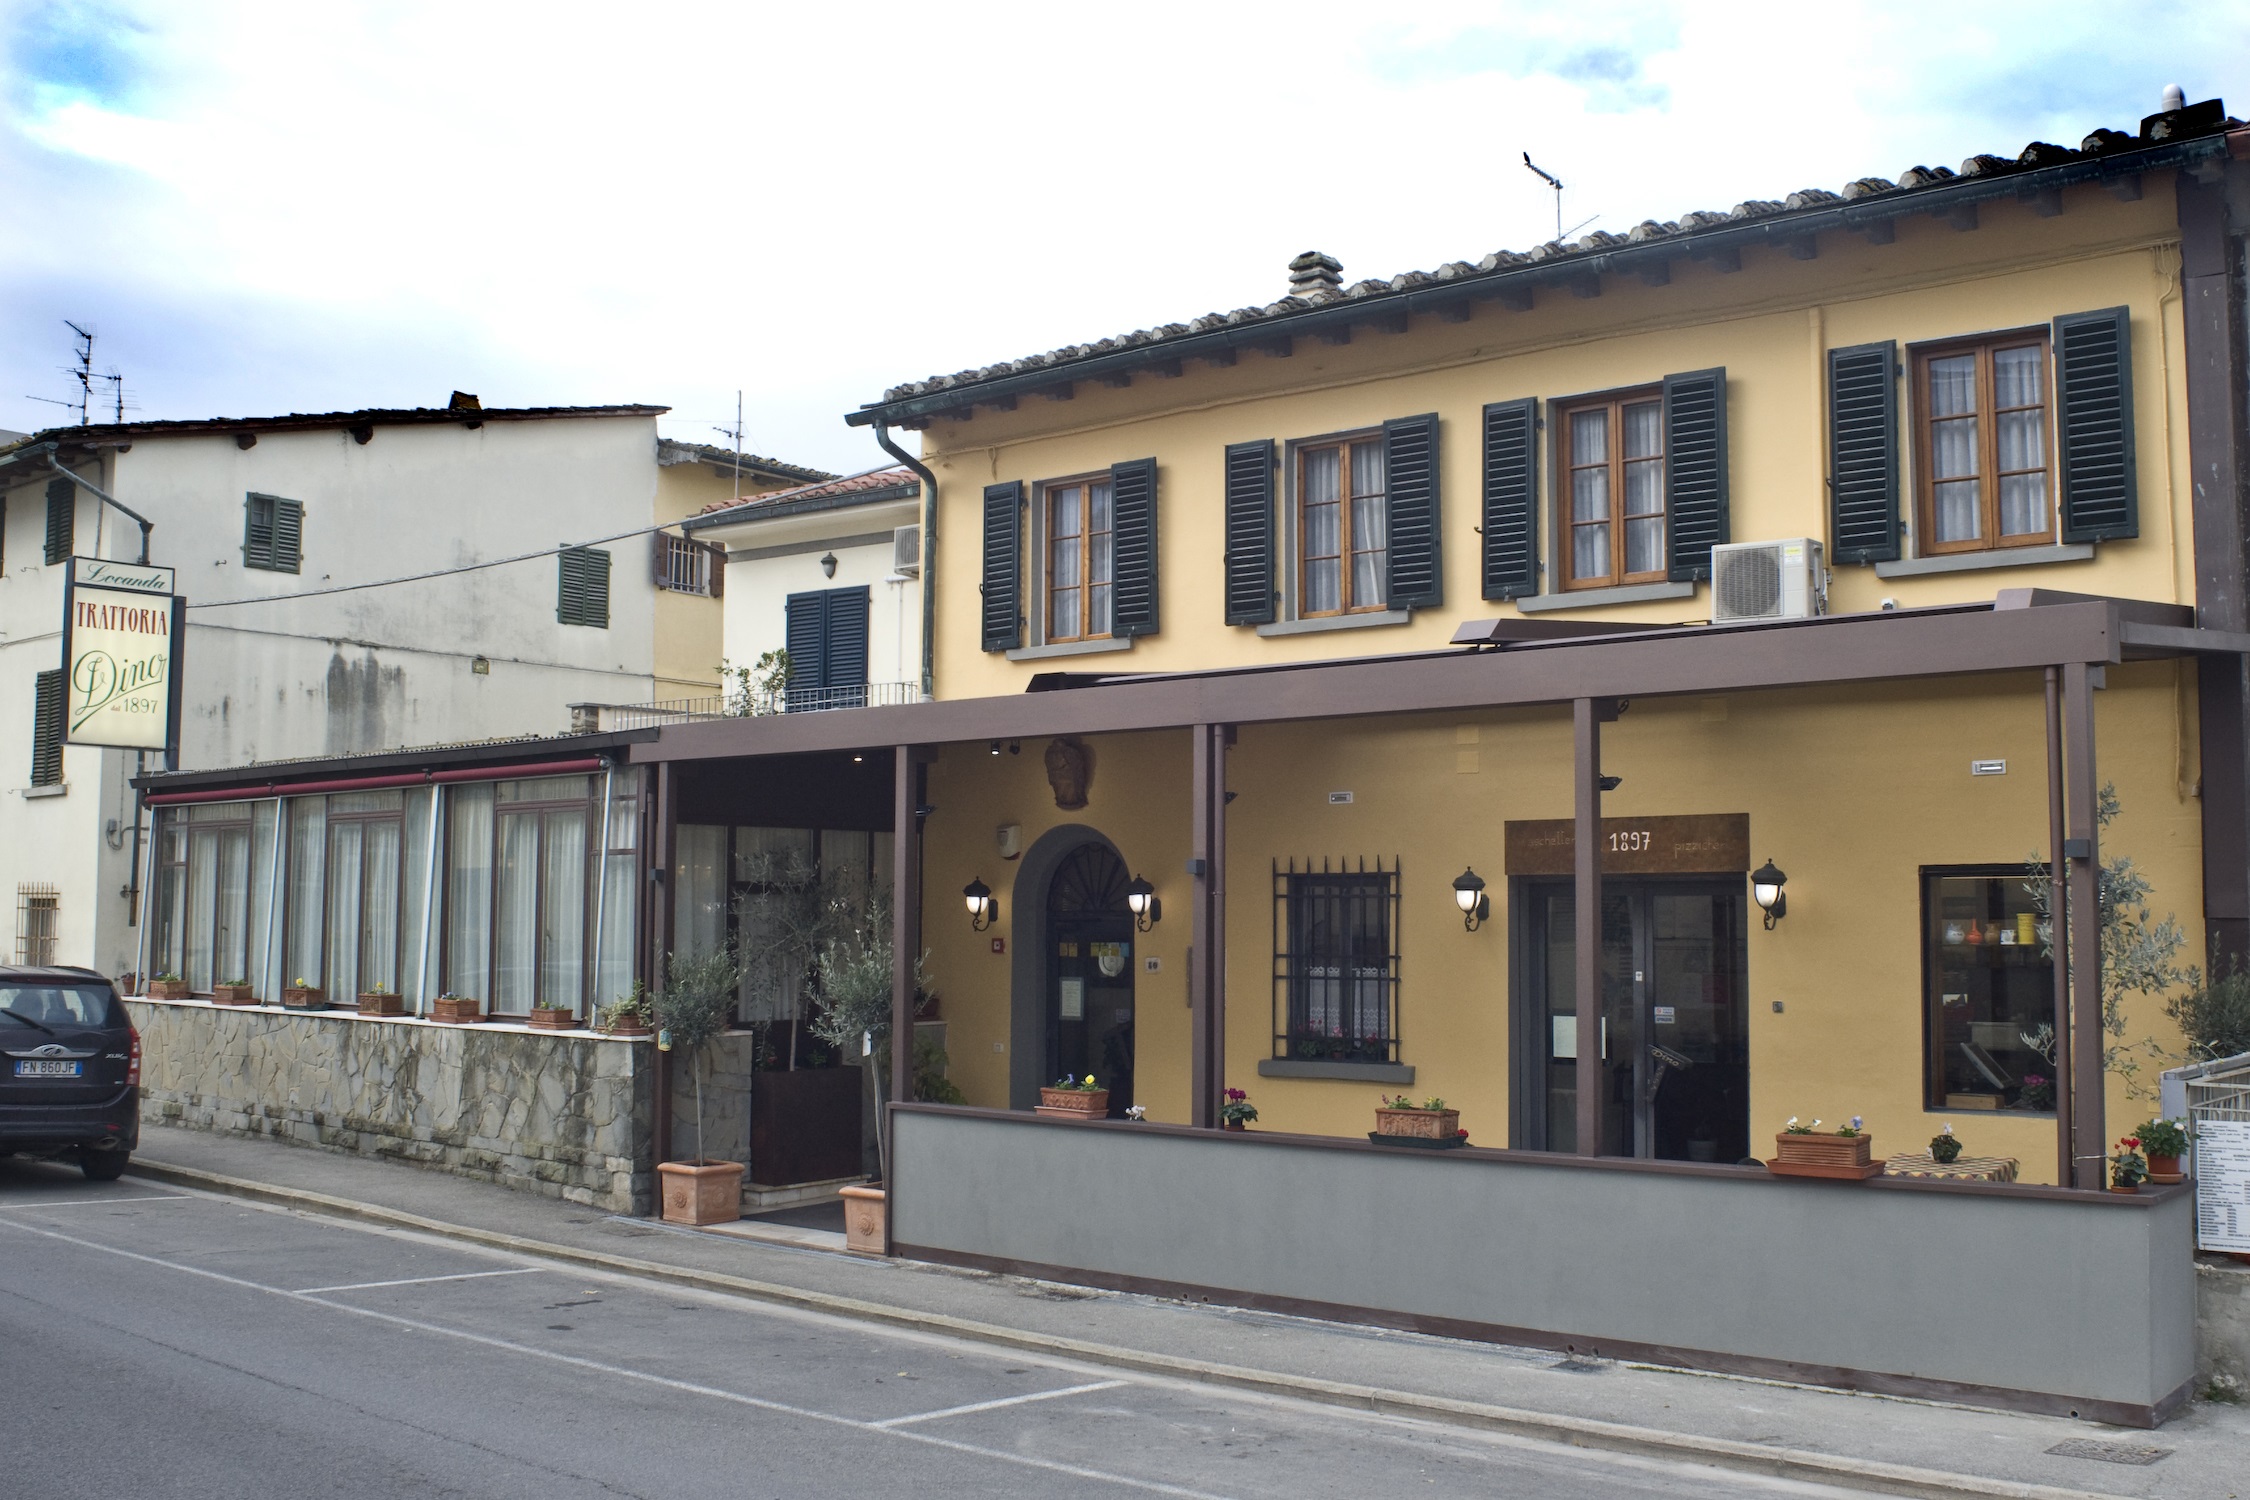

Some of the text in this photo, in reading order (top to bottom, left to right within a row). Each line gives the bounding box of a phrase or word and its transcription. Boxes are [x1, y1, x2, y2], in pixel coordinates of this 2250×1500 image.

[82, 563, 166, 590] Locanda
[76, 601, 168, 636] TRATTORIA
[72, 649, 168, 717] Dino
[123, 697, 159, 714] 1897
[1608, 831, 1651, 852] 1897
[22, 1061, 75, 1073] FN 860JF
